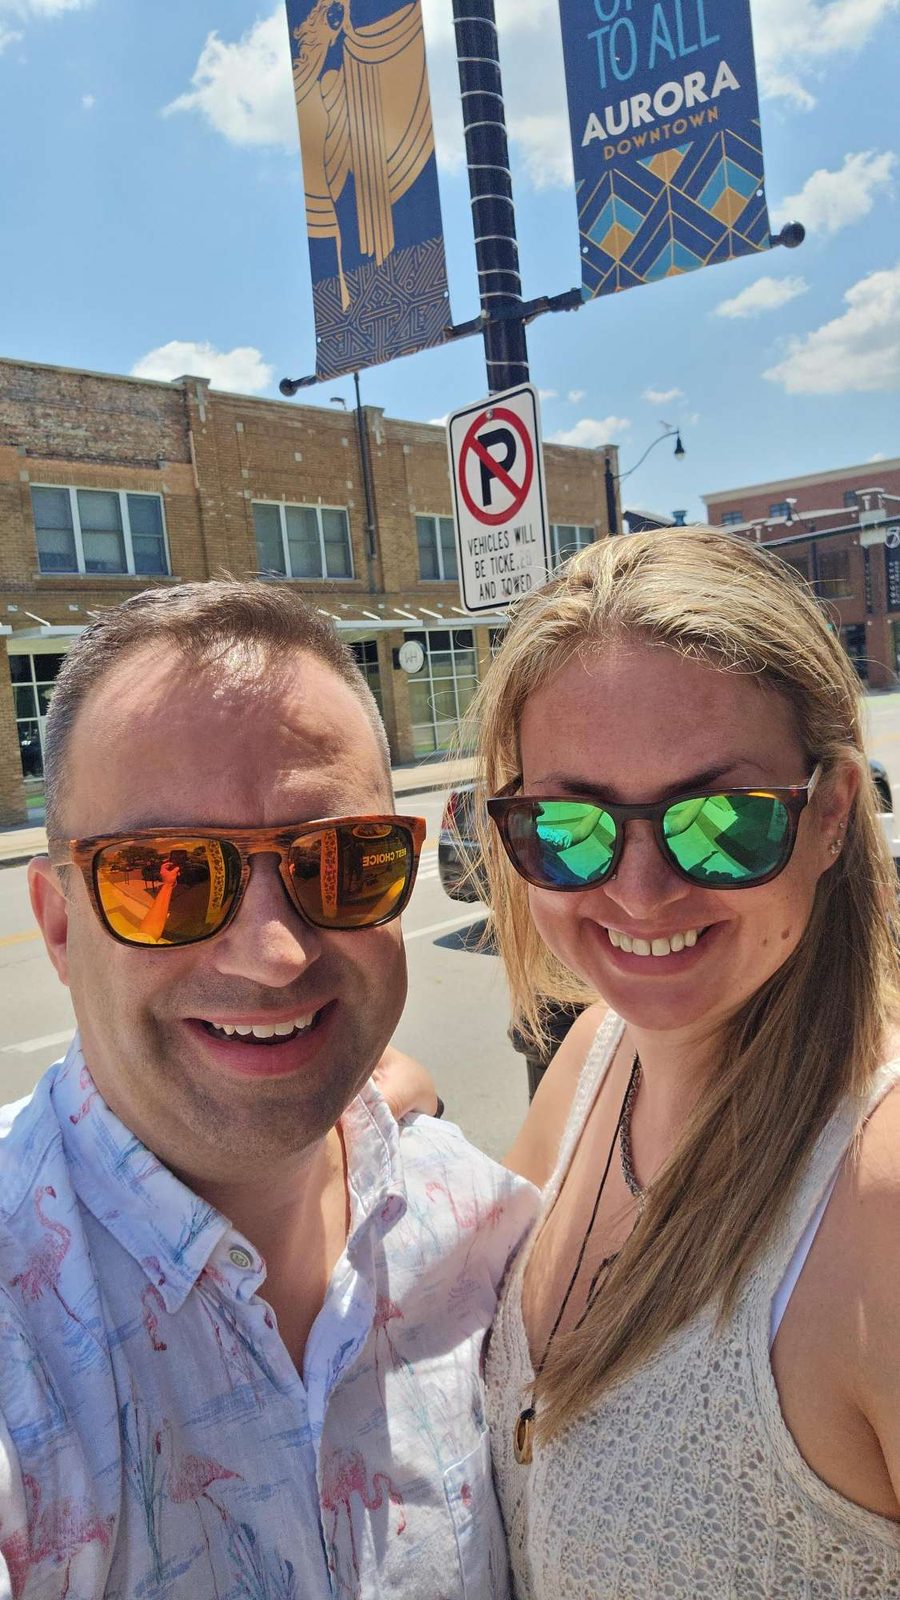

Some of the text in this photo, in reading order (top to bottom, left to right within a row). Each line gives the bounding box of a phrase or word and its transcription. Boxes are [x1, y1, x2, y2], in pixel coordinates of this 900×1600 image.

[587, 0, 720, 88] TO ALL
[581, 60, 741, 147] AURORA
[604, 106, 719, 160] DOWNTOWN
[467, 524, 536, 557] VEHICLES WILL
[474, 551, 533, 579] BE TICKE
[480, 573, 532, 601] AND TOWED
